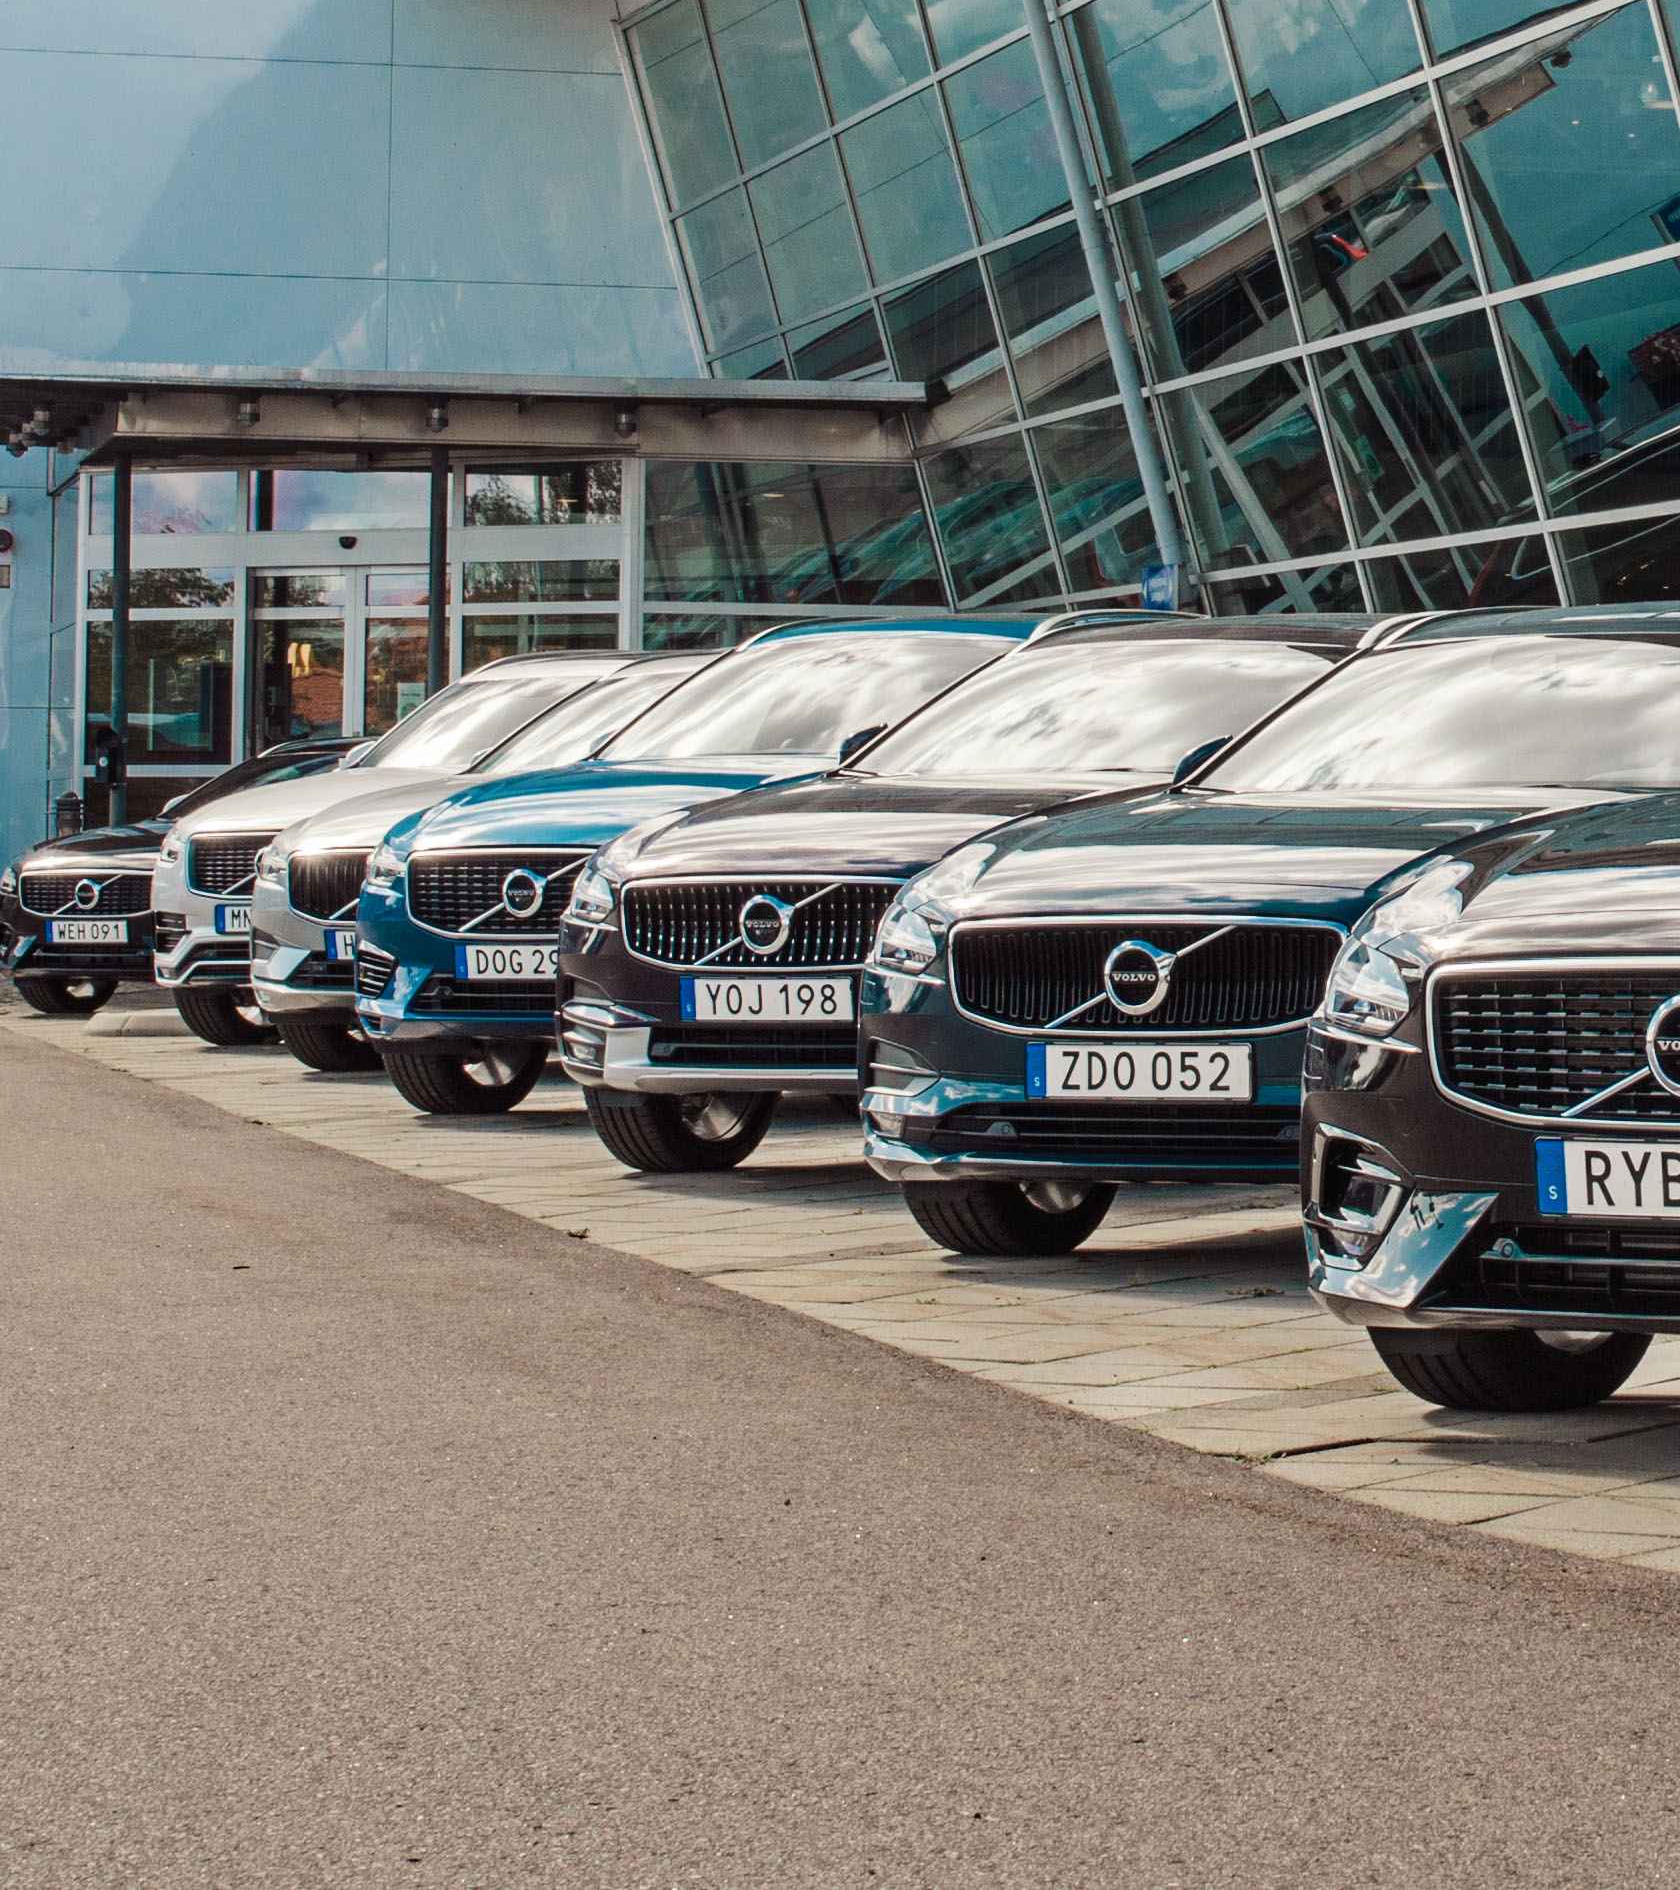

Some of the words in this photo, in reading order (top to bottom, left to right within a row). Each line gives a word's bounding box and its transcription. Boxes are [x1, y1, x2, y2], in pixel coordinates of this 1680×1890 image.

[231, 910, 252, 928] MN
[58, 924, 86, 940] WEH
[91, 924, 121, 940] 091
[476, 949, 526, 975] DOG
[533, 949, 559, 975] 29
[1111, 973, 1157, 982] VOLVO
[705, 984, 764, 1015] YOJ
[779, 983, 838, 1015] 198
[1061, 1051, 1135, 1091] ZDO
[1152, 1051, 1230, 1092] 052
